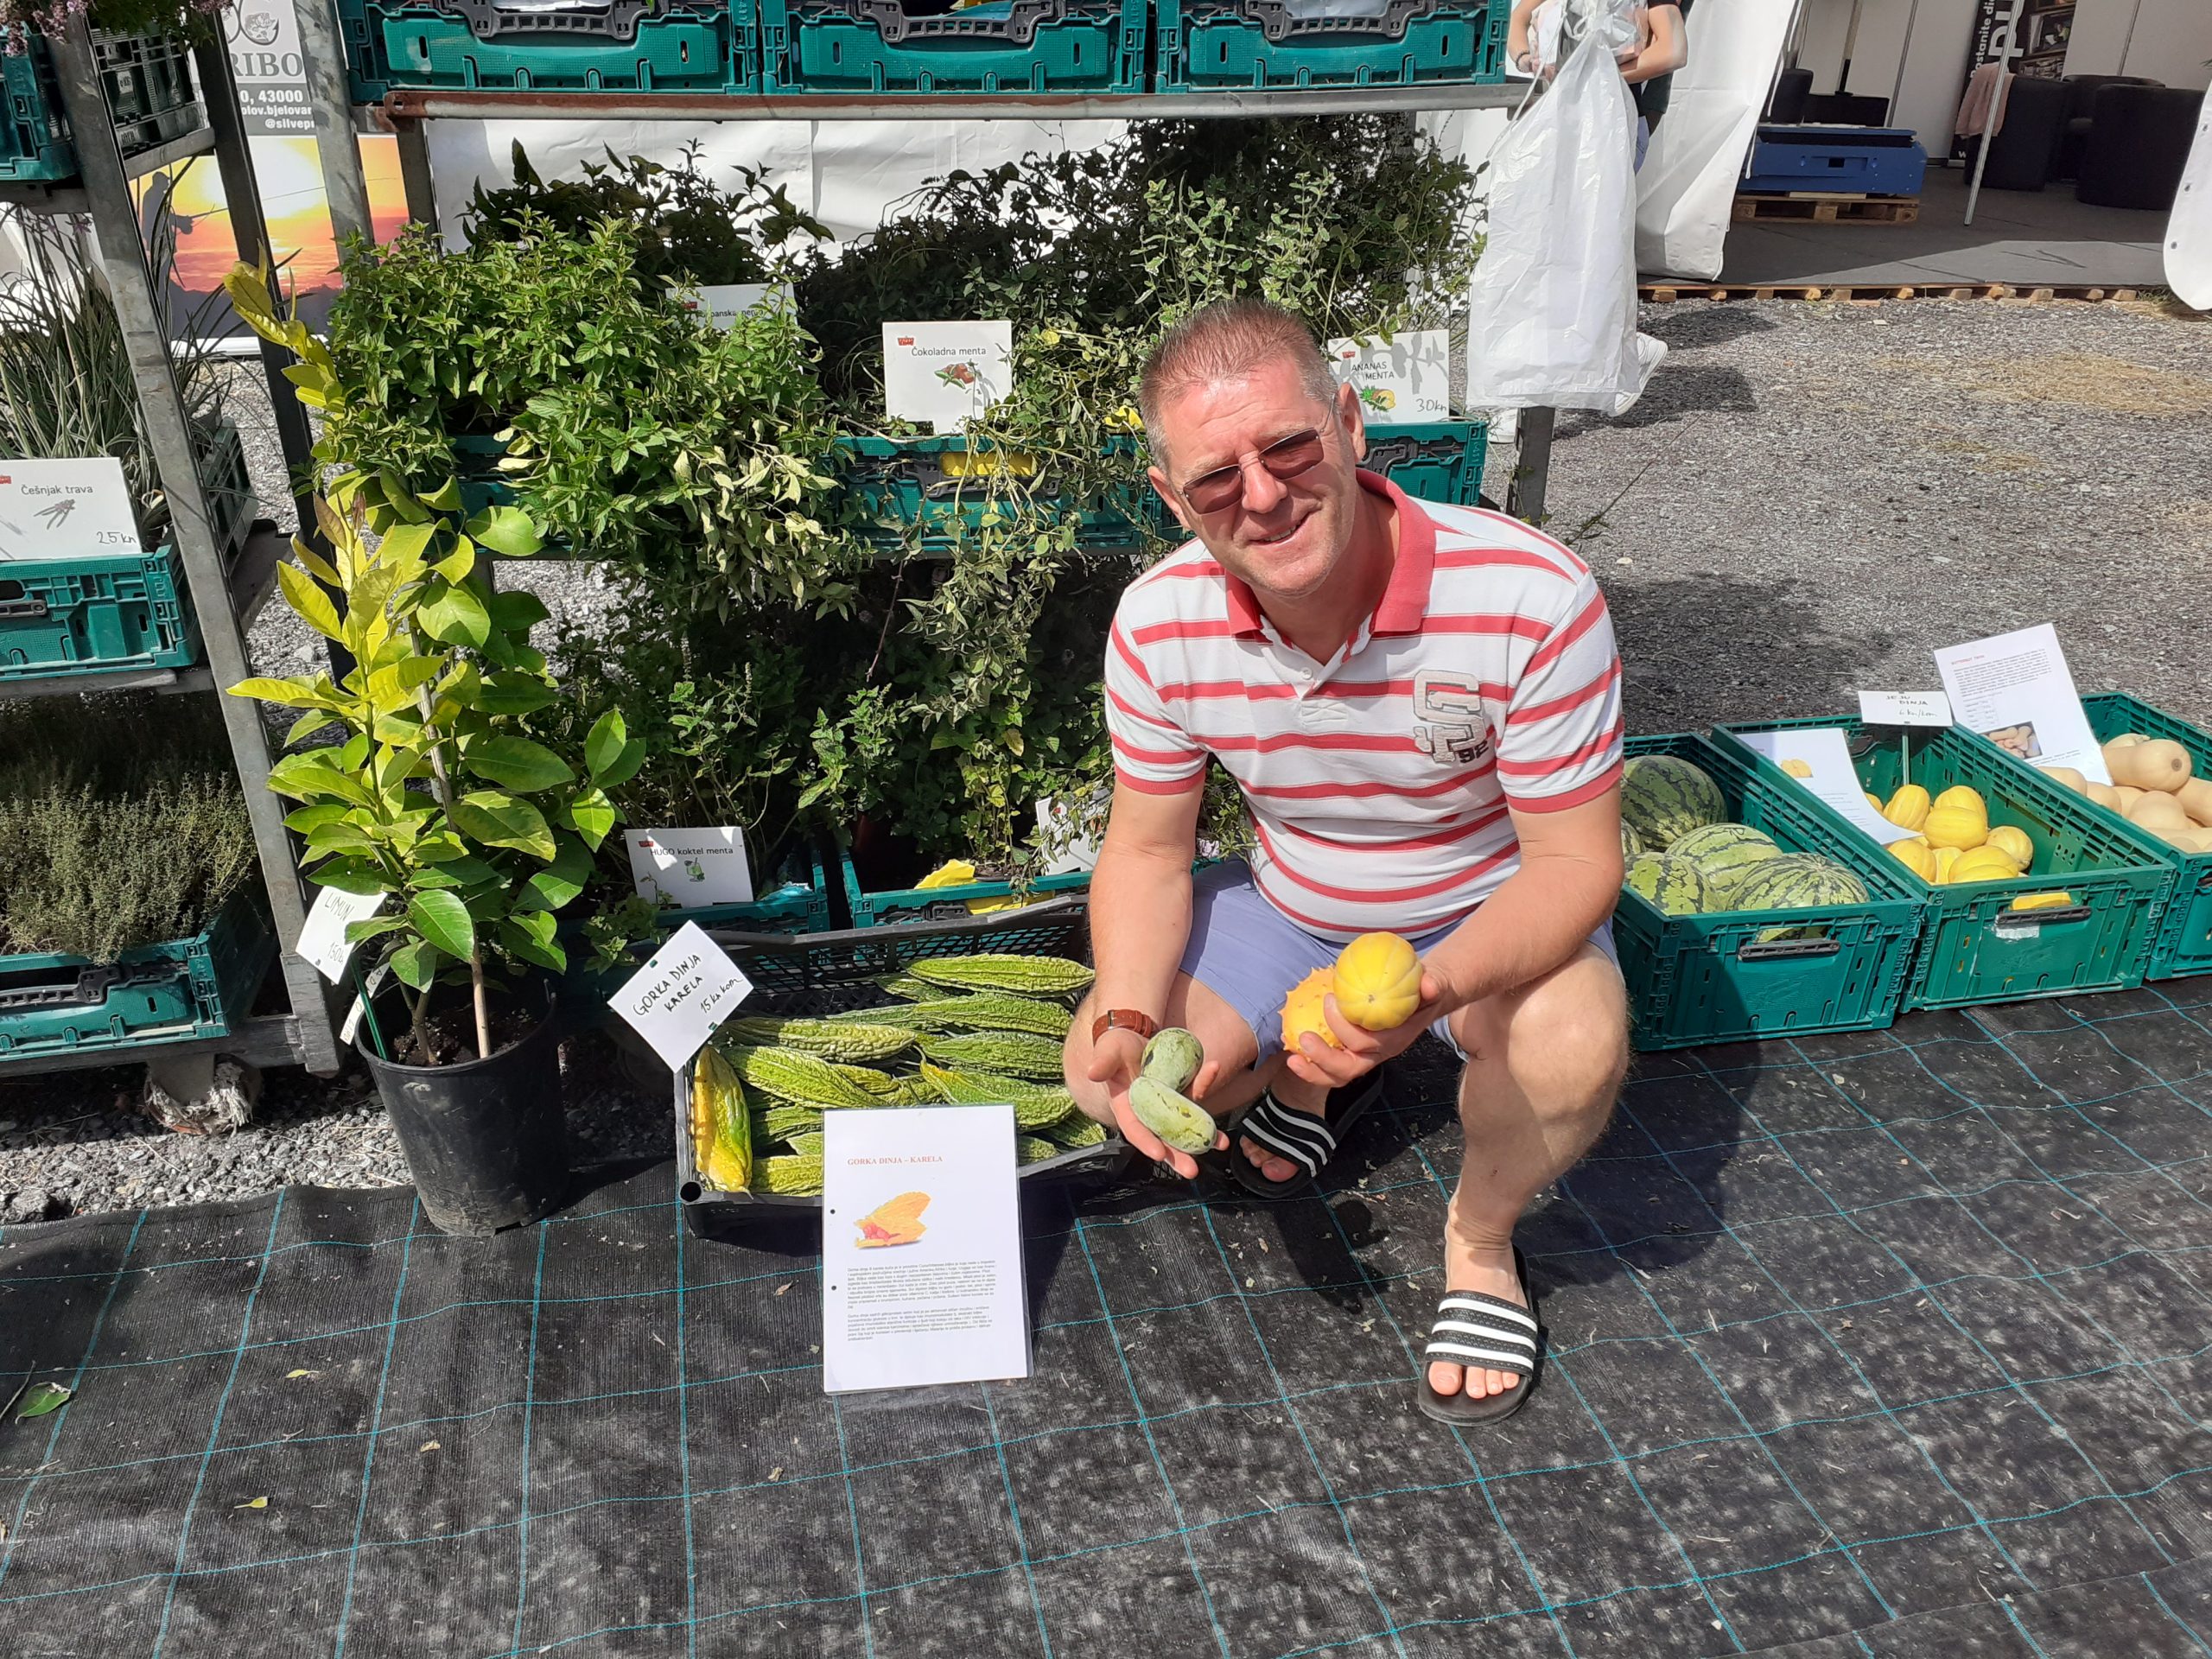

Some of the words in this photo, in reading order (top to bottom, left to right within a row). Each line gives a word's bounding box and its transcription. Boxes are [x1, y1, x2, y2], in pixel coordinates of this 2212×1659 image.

[257, 90, 303, 103] 43000
[911, 346, 957, 357] Čokoladna
[958, 347, 987, 356] menta
[1351, 361, 1388, 372] ANANAS
[1365, 371, 1395, 381] MENTA
[21, 484, 62, 497] Češnjak
[65, 485, 93, 494] trava
[650, 848, 675, 856] HUGO
[324, 892, 355, 922] LIMUN
[632, 979, 671, 1016] GORKA
[669, 953, 702, 982] DINJA
[664, 976, 703, 1013] KARELA
